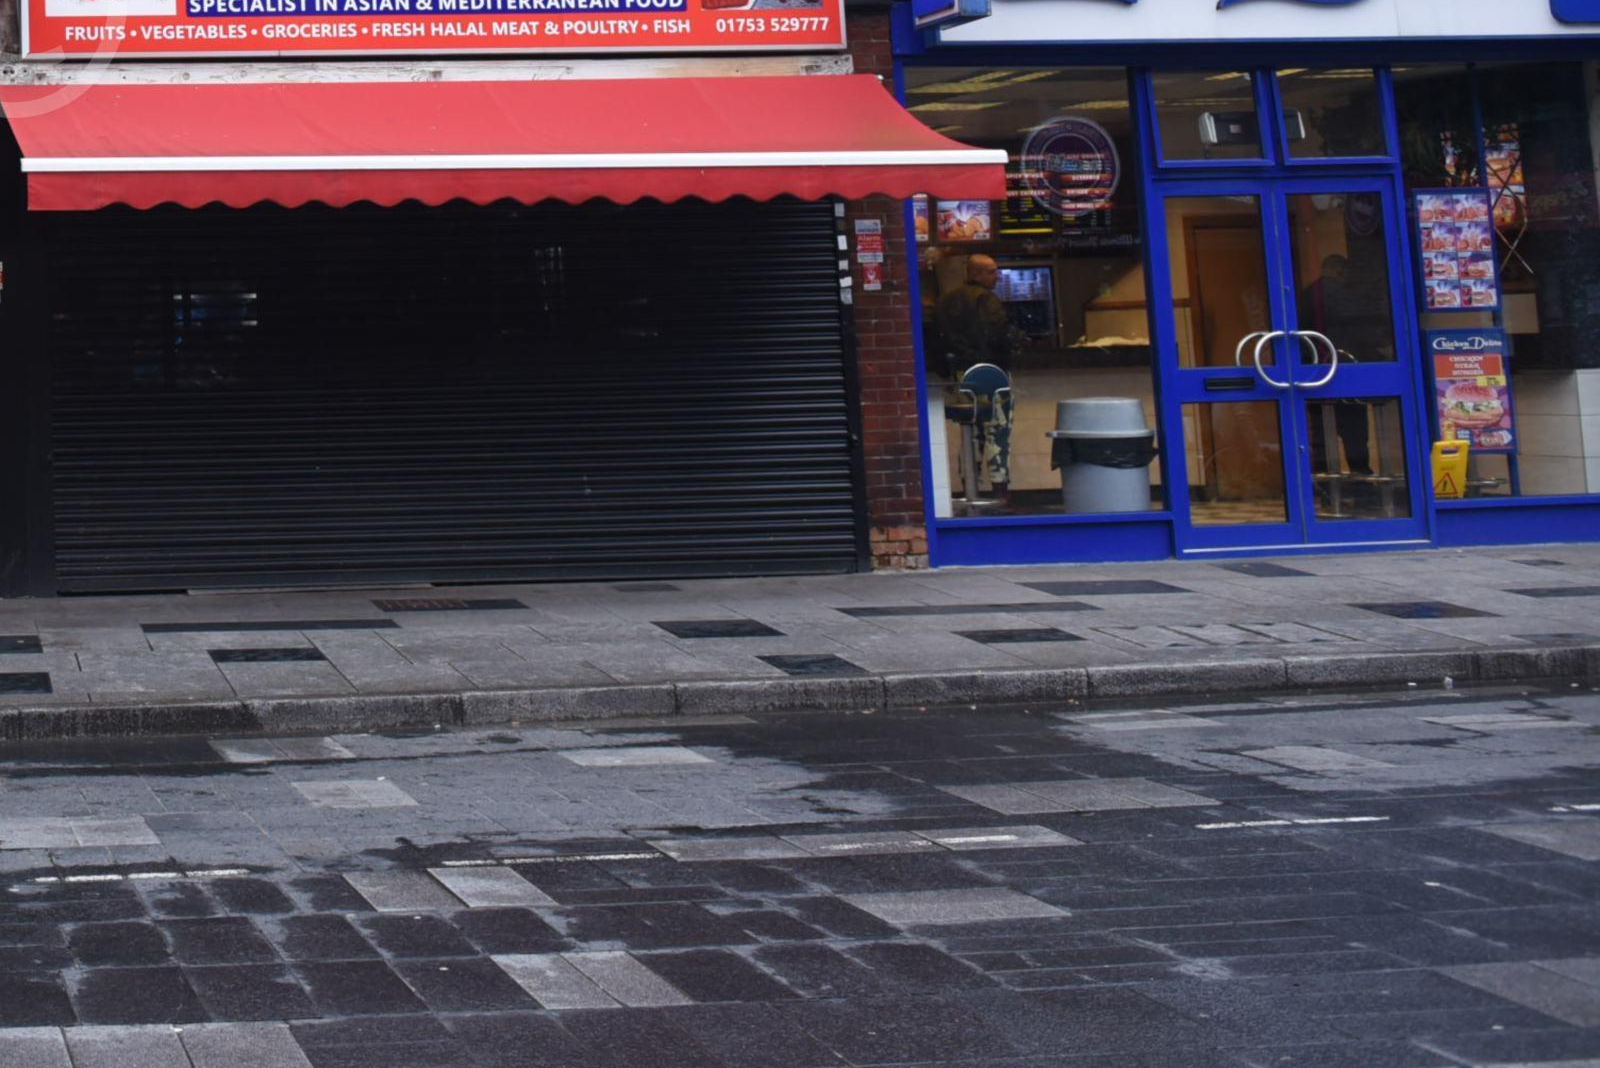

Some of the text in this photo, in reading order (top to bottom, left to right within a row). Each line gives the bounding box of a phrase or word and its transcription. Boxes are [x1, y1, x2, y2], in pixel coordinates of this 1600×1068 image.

[65, 19, 690, 41] FRUITS VEGETABLES GROCERIES FRESH HALAL MEAT & POULTRY FISH
[716, 17, 829, 33] 01753 529777
